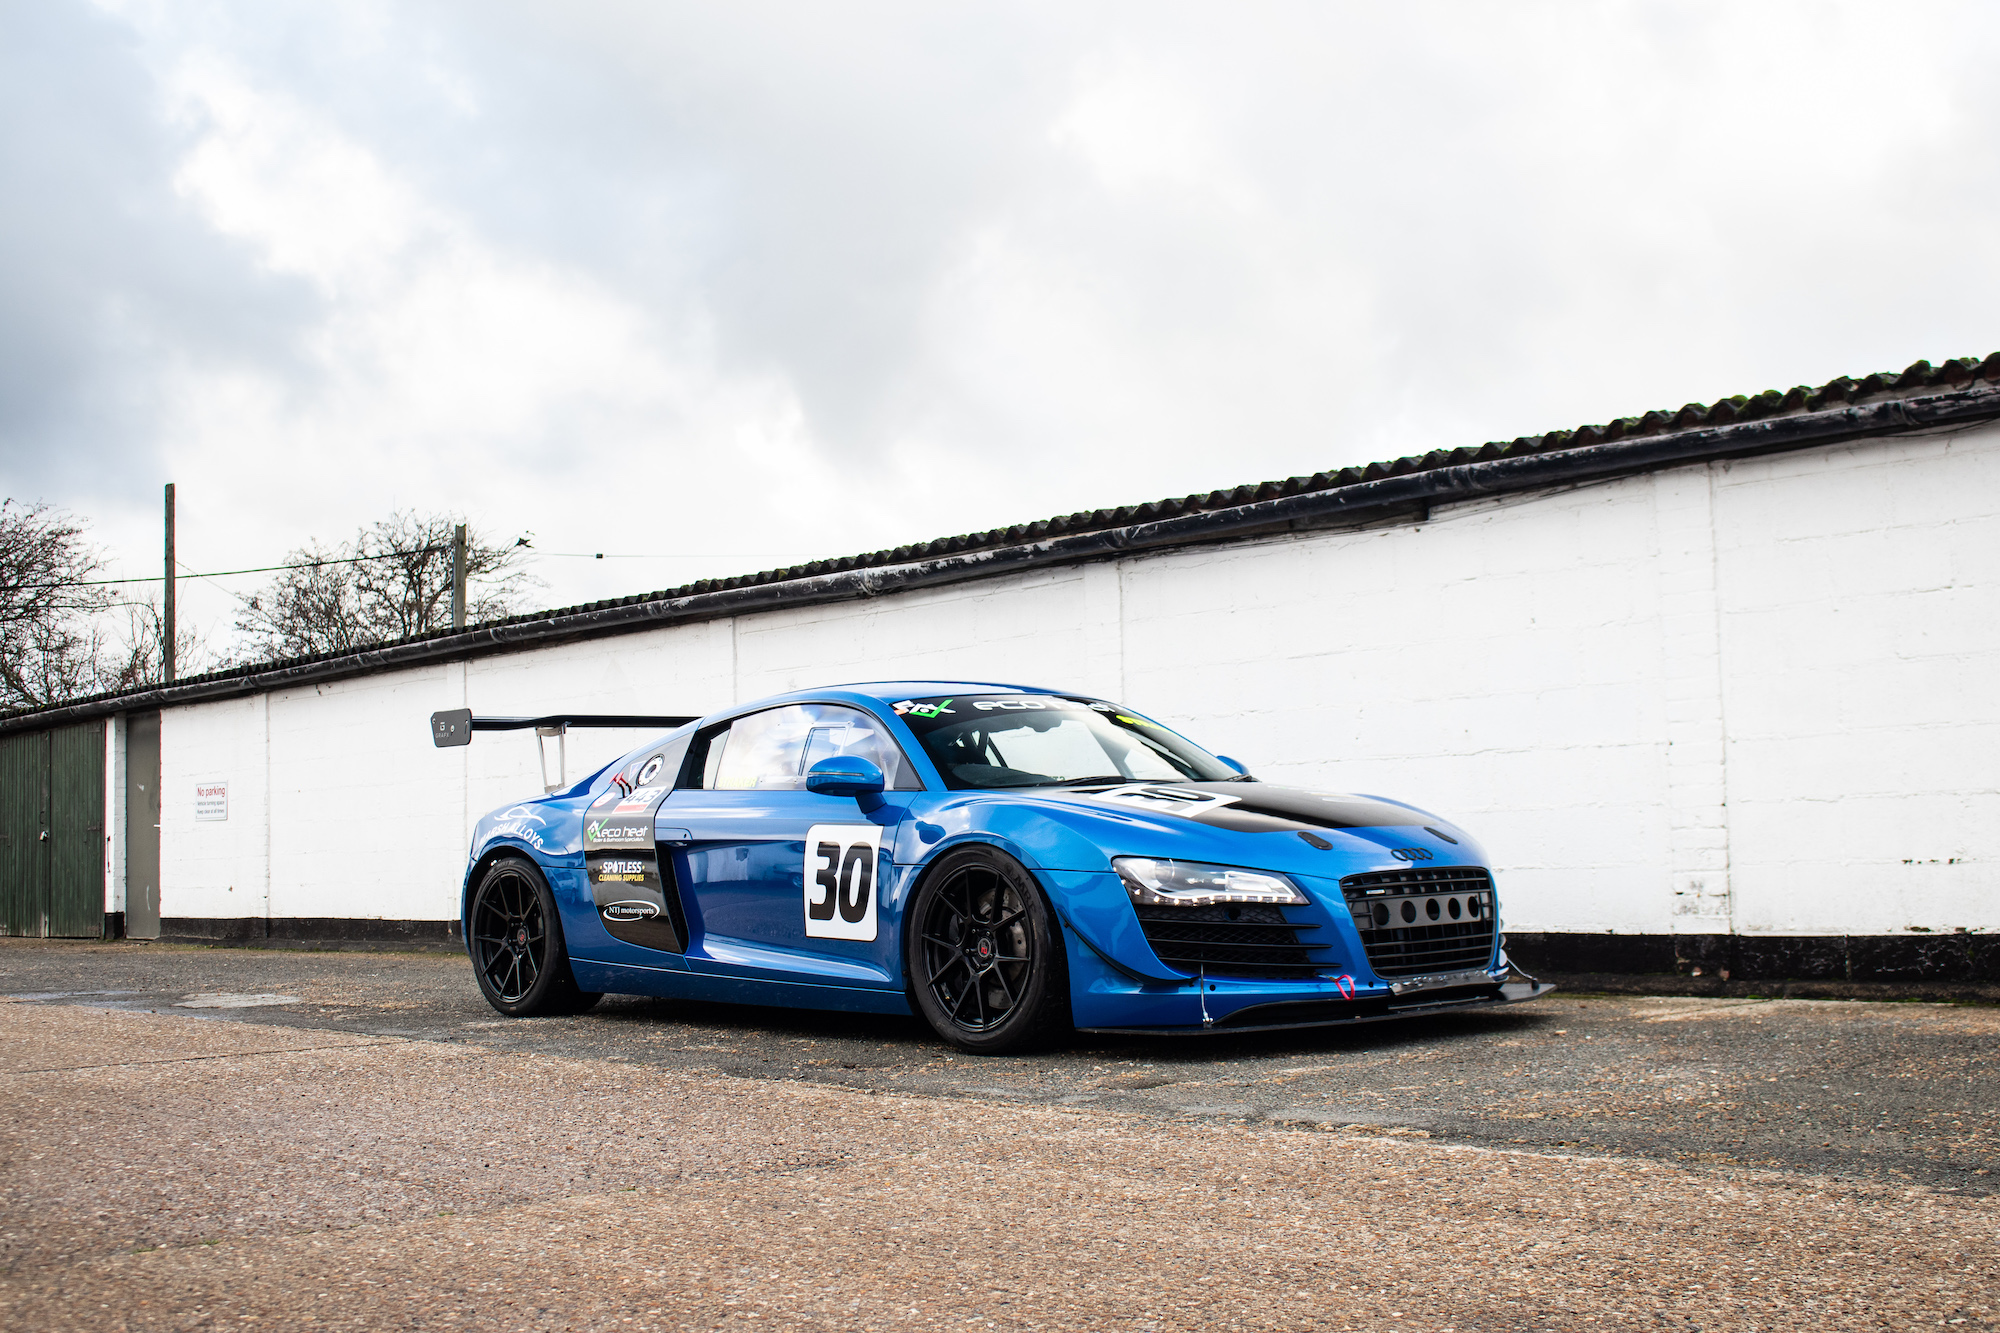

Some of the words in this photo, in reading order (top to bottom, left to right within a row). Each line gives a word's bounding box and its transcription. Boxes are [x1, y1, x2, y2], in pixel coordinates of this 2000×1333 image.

[973, 701, 1046, 710] eco
[197, 786, 204, 797] No
[205, 785, 226, 798] parking
[1114, 787, 1216, 812] 30
[478, 822, 511, 847] MARSH
[508, 822, 544, 850] ALLOYS
[601, 828, 621, 838] eco
[622, 825, 649, 838] heat
[602, 861, 643, 873] SPOTLESS
[809, 841, 873, 924] 30
[608, 906, 620, 915] NTJ
[620, 907, 655, 916] motorsports
